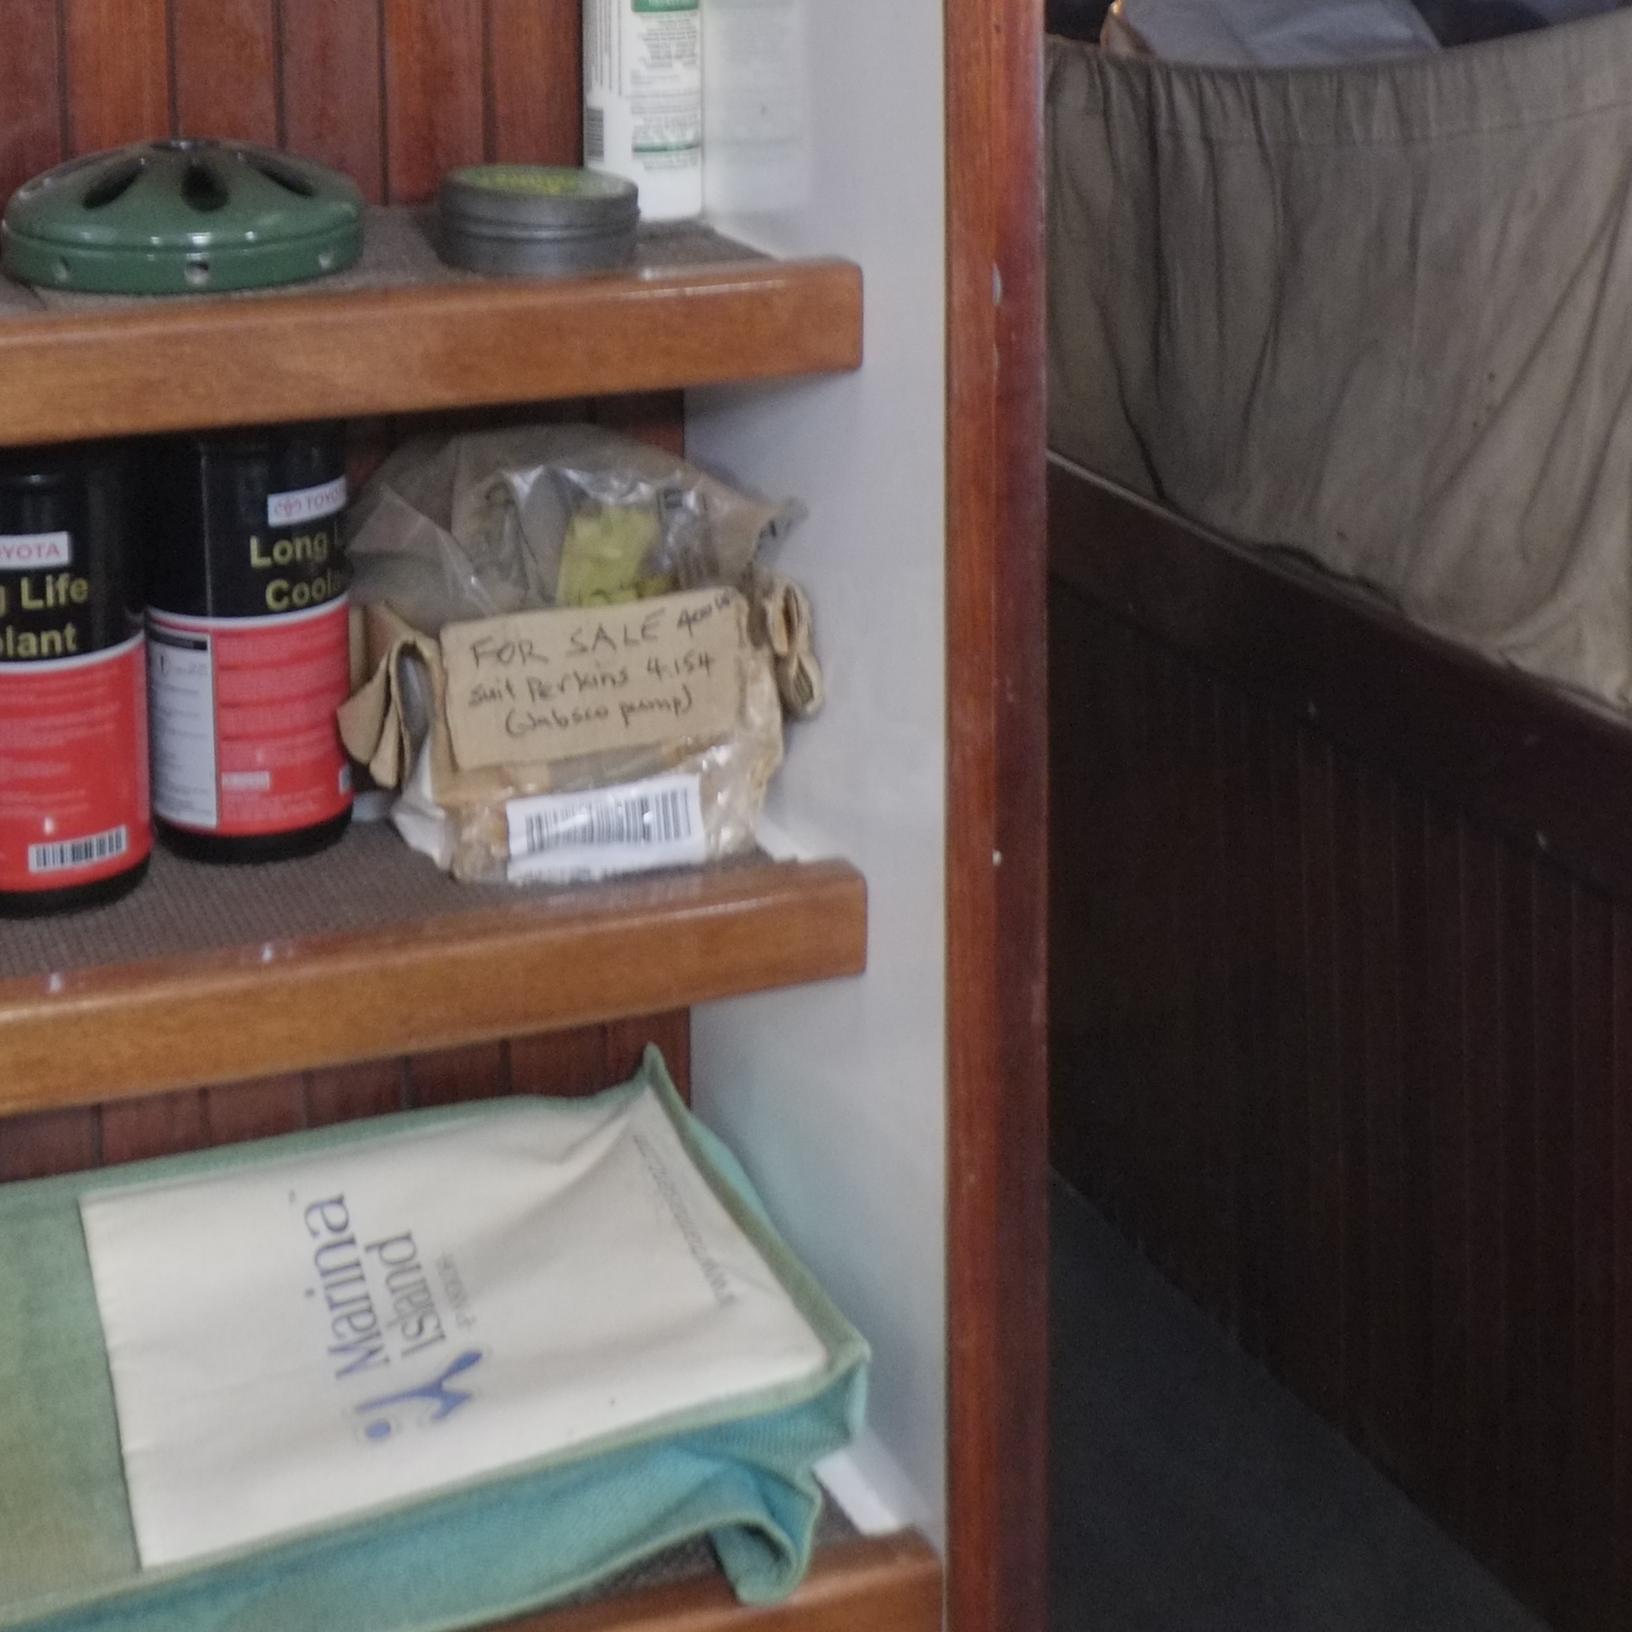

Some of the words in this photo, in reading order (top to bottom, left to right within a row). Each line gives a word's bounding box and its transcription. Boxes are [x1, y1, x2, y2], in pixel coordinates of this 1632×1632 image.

[249, 531, 327, 569] Long
[20, 571, 89, 609] Life
[469, 636, 549, 669] FOR
[567, 607, 665, 657] SALE
[526, 661, 629, 703] Perkins
[304, 1193, 391, 1380] Marina
[364, 1230, 447, 1359] Island
